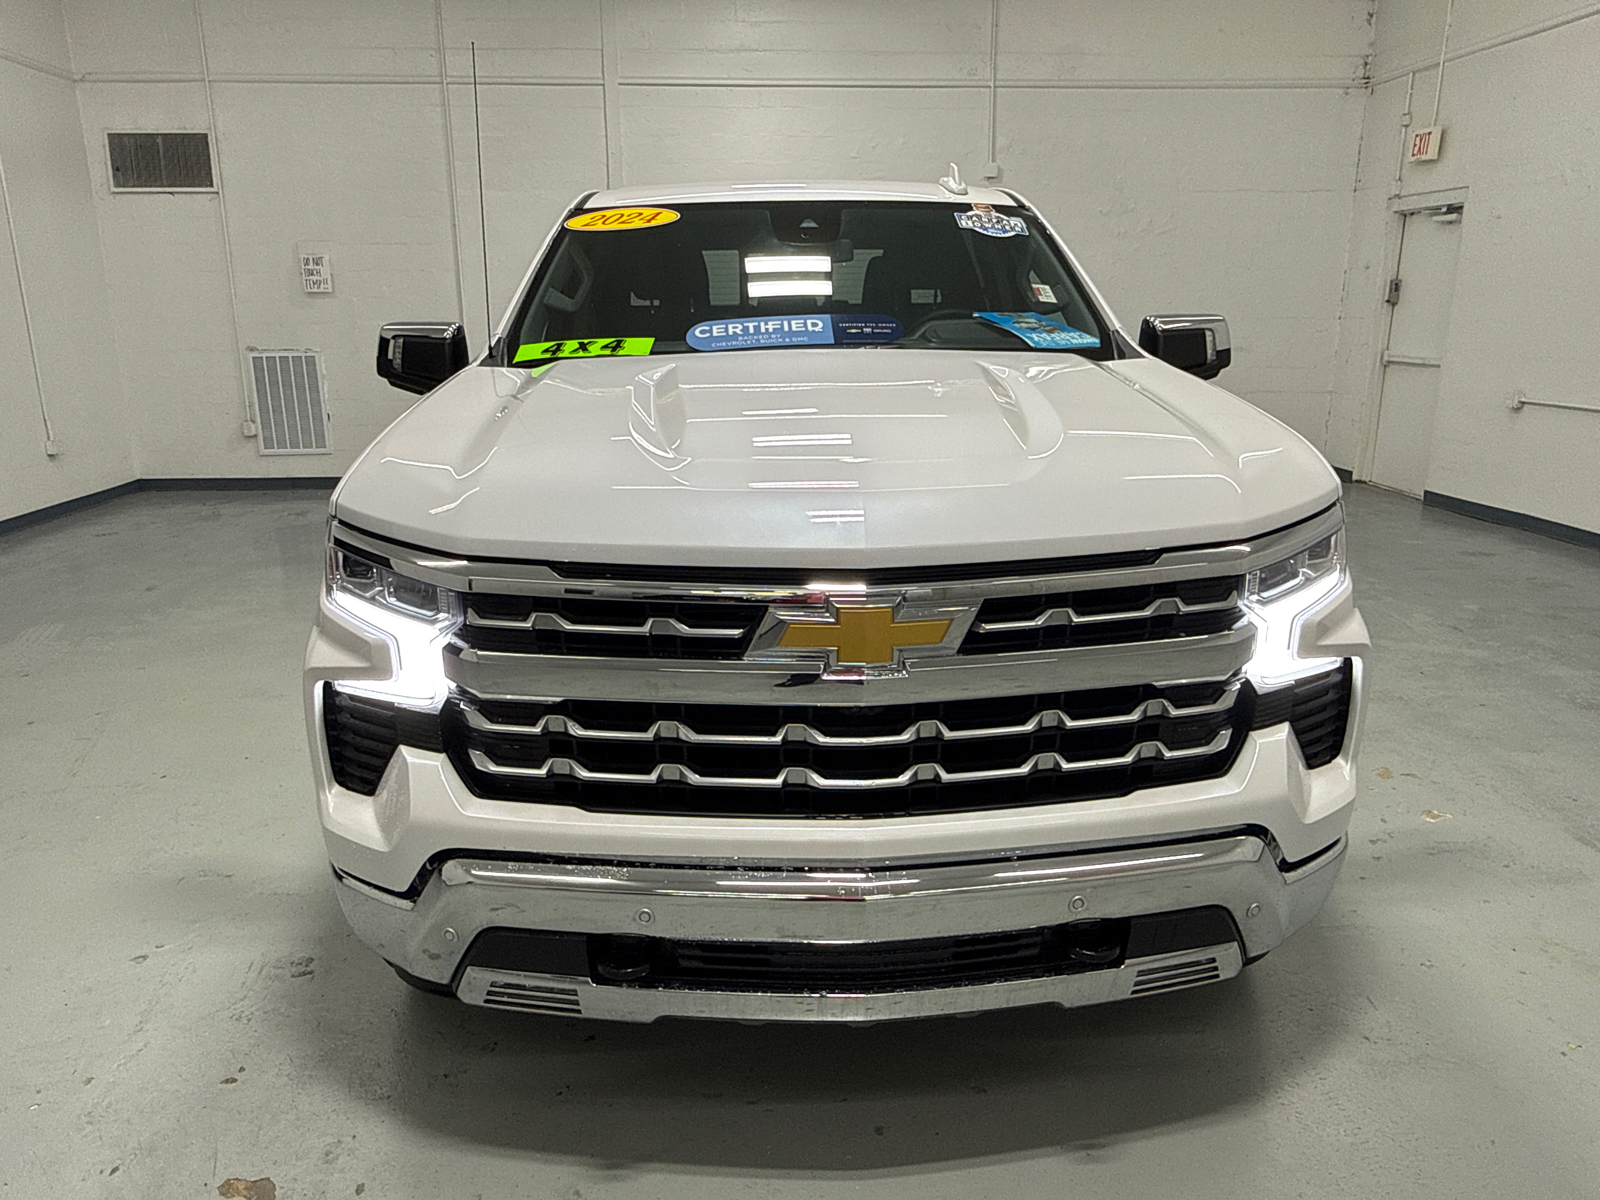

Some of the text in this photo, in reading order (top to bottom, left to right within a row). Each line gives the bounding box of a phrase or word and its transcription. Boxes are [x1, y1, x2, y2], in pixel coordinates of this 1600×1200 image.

[1412, 131, 1432, 157] EXIT
[580, 211, 663, 228] 2024
[302, 256, 325, 267] DO NOT
[303, 268, 322, 278] TOUCH
[694, 319, 824, 338] CERTIFIED
